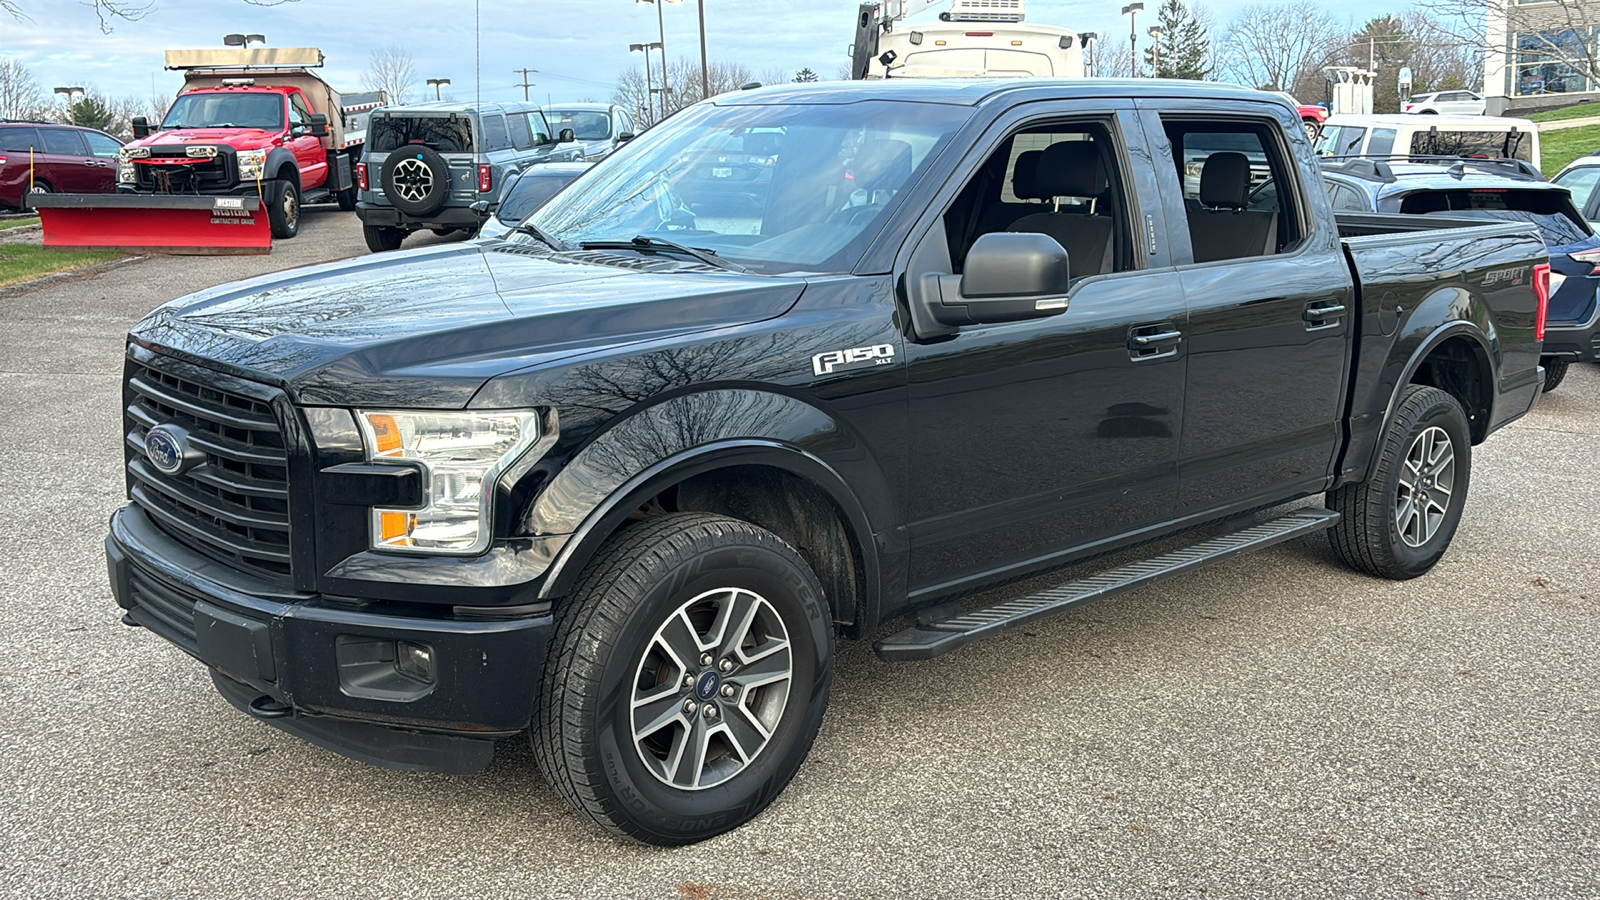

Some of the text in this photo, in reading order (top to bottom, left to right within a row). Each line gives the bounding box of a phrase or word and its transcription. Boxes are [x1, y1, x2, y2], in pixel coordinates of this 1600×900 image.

[217, 199, 241, 208] WESTERN
[1481, 265, 1530, 287] SPORT
[875, 358, 892, 366] XLT
[149, 437, 171, 465] Ford
[605, 752, 622, 785] PLUS
